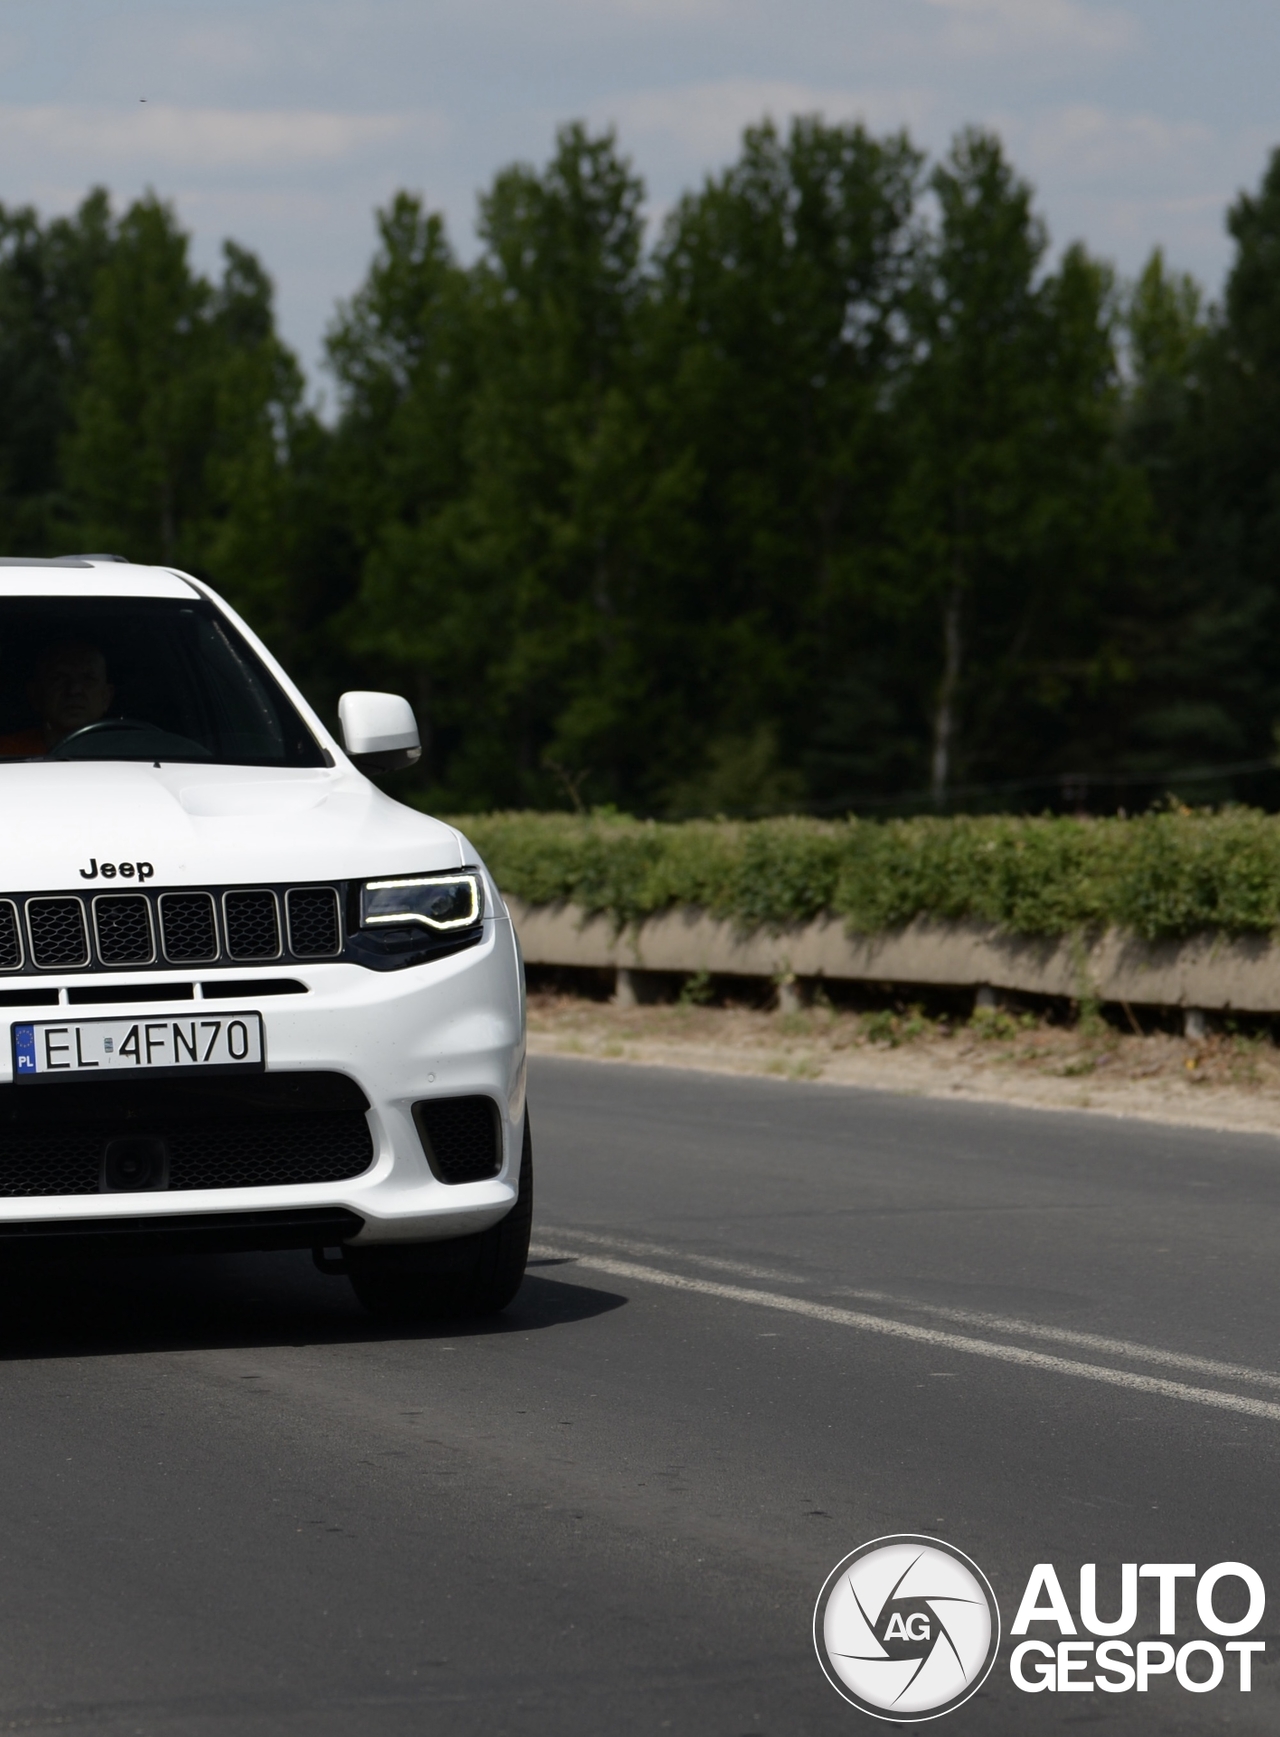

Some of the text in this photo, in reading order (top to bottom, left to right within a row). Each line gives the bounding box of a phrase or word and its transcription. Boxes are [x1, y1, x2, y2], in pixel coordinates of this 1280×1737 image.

[79, 858, 154, 882] Jeep
[44, 1020, 249, 1069] EL 4FN70
[18, 1055, 34, 1068] PL
